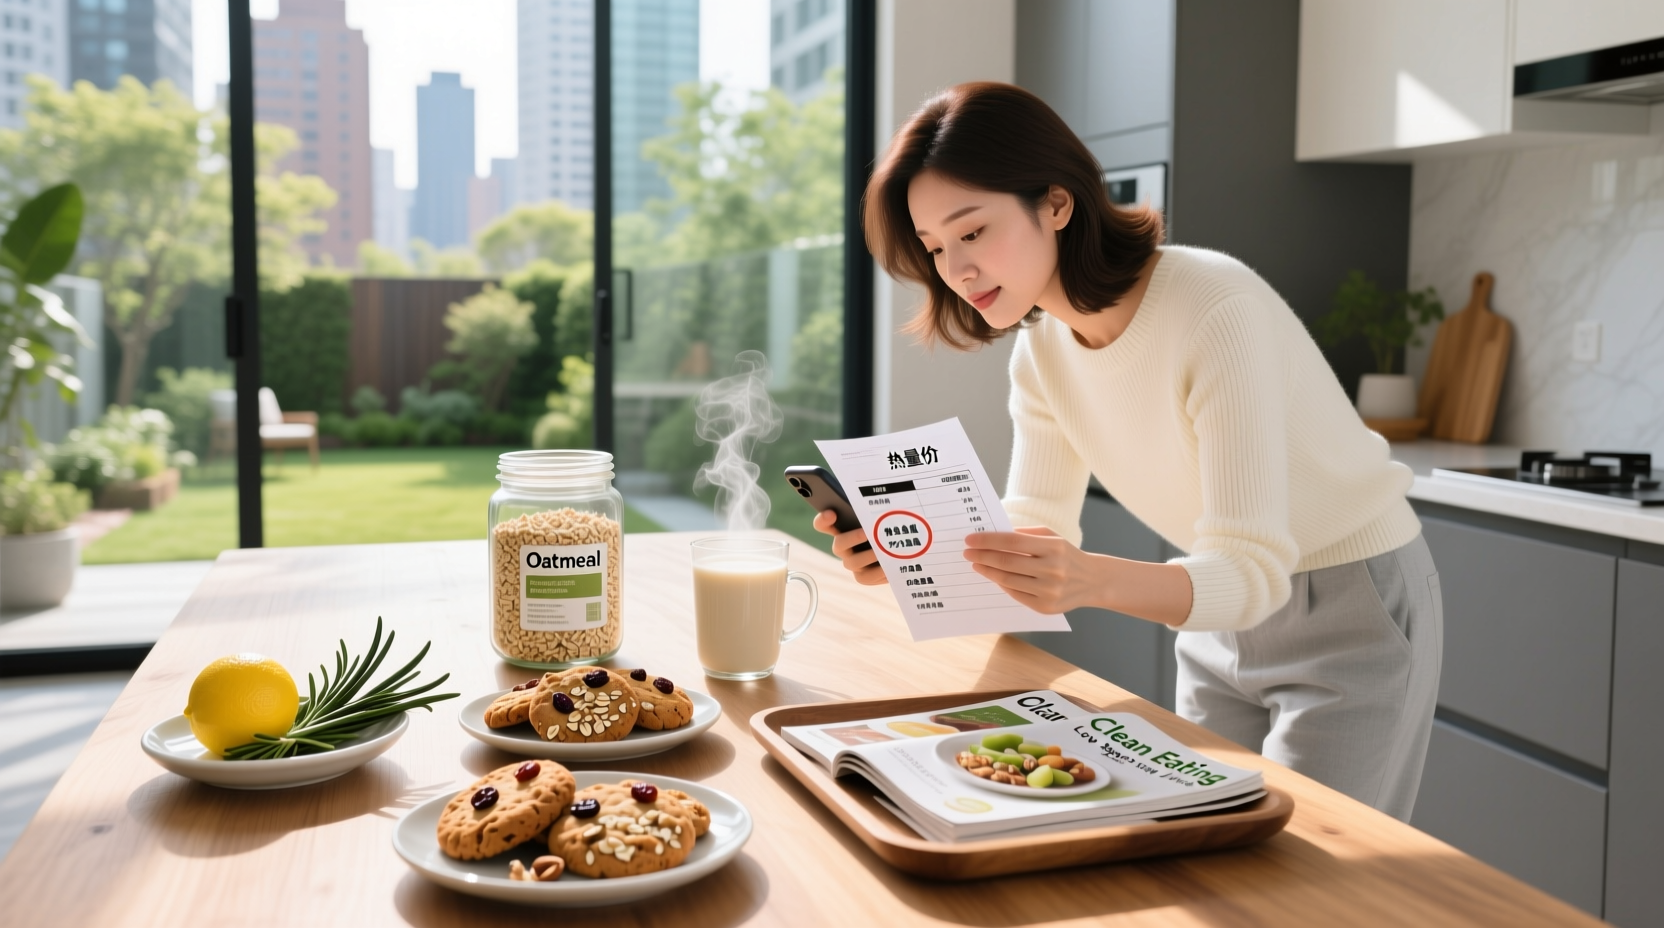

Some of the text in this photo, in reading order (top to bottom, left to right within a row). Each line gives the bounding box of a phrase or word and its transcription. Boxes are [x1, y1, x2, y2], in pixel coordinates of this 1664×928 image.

[887, 445, 938, 470] 热量价
[526, 550, 600, 569] Oatmeal
[1091, 718, 1152, 756] Clean
[1150, 751, 1228, 786] Eating
